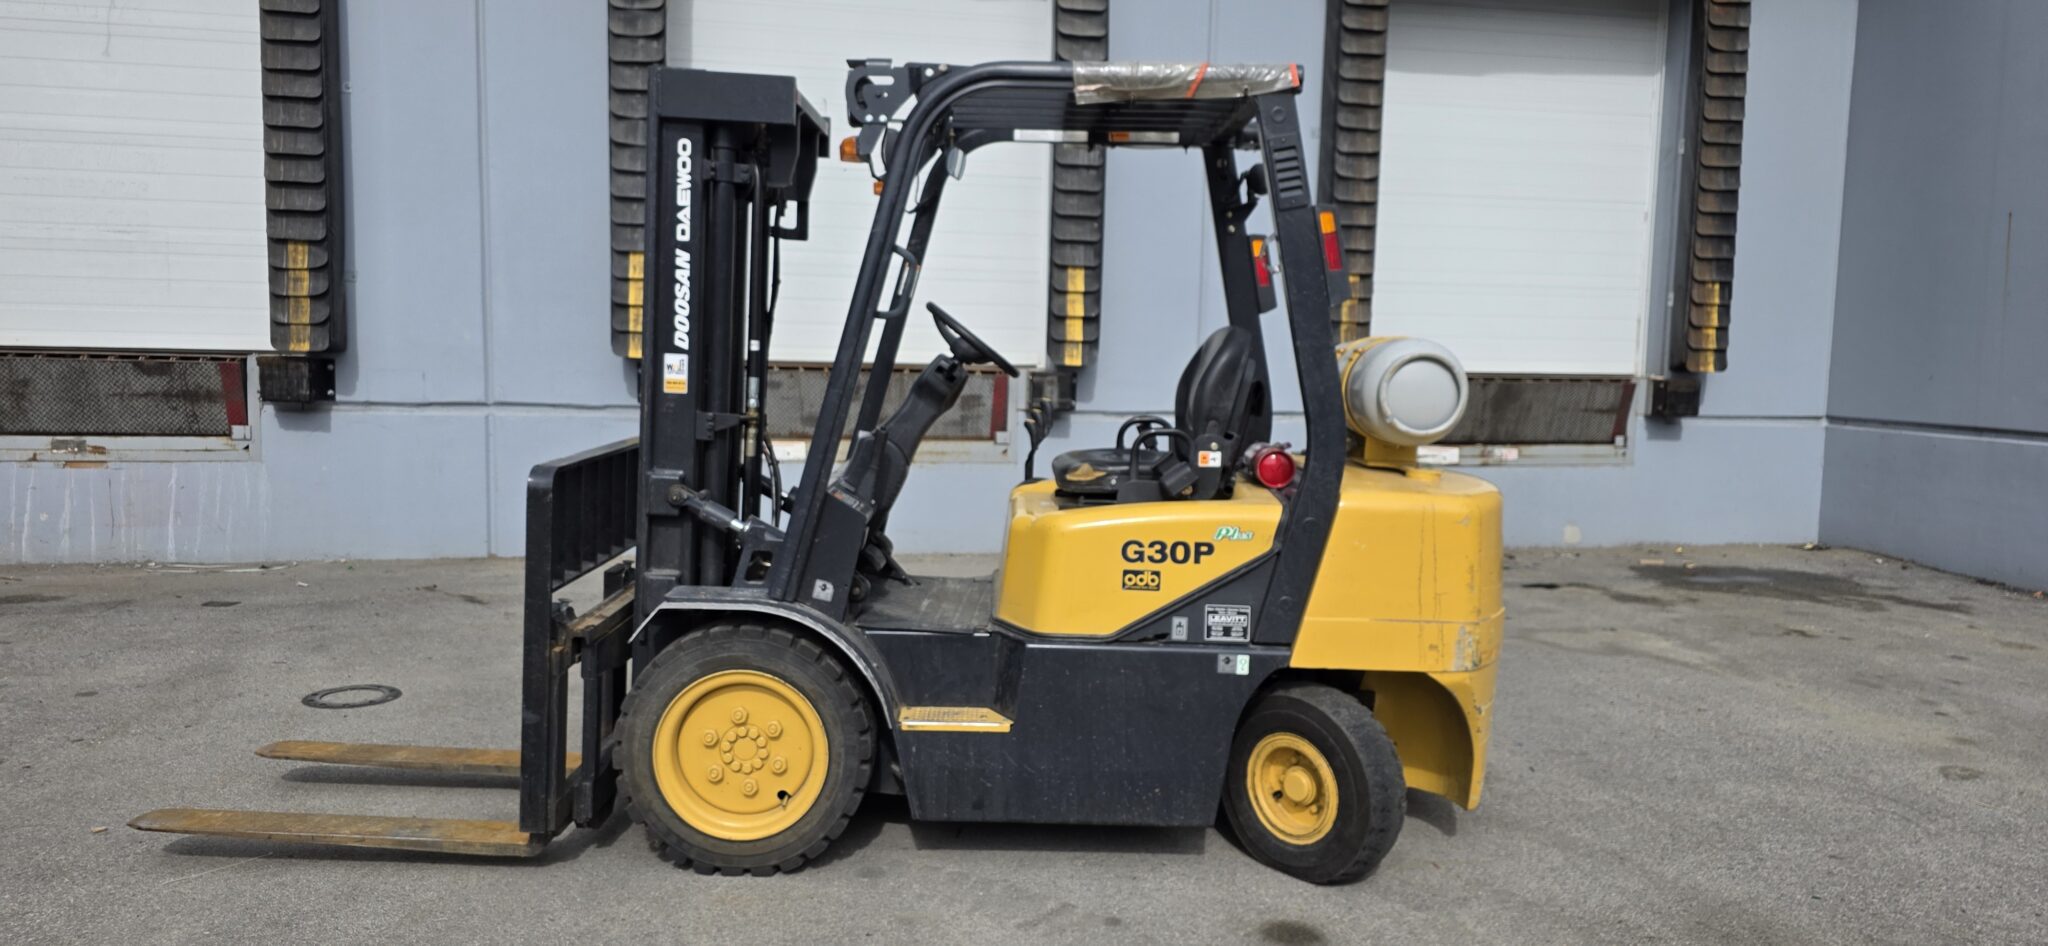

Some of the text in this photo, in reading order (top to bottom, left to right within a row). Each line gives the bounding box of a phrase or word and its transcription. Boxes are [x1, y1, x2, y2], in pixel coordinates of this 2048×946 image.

[676, 138, 692, 242] DAEWOO
[674, 248, 691, 351] DOOSAN
[1121, 539, 1215, 564] G30P
[1124, 571, 1160, 586] odb
[1210, 615, 1247, 623] LEAVITT
